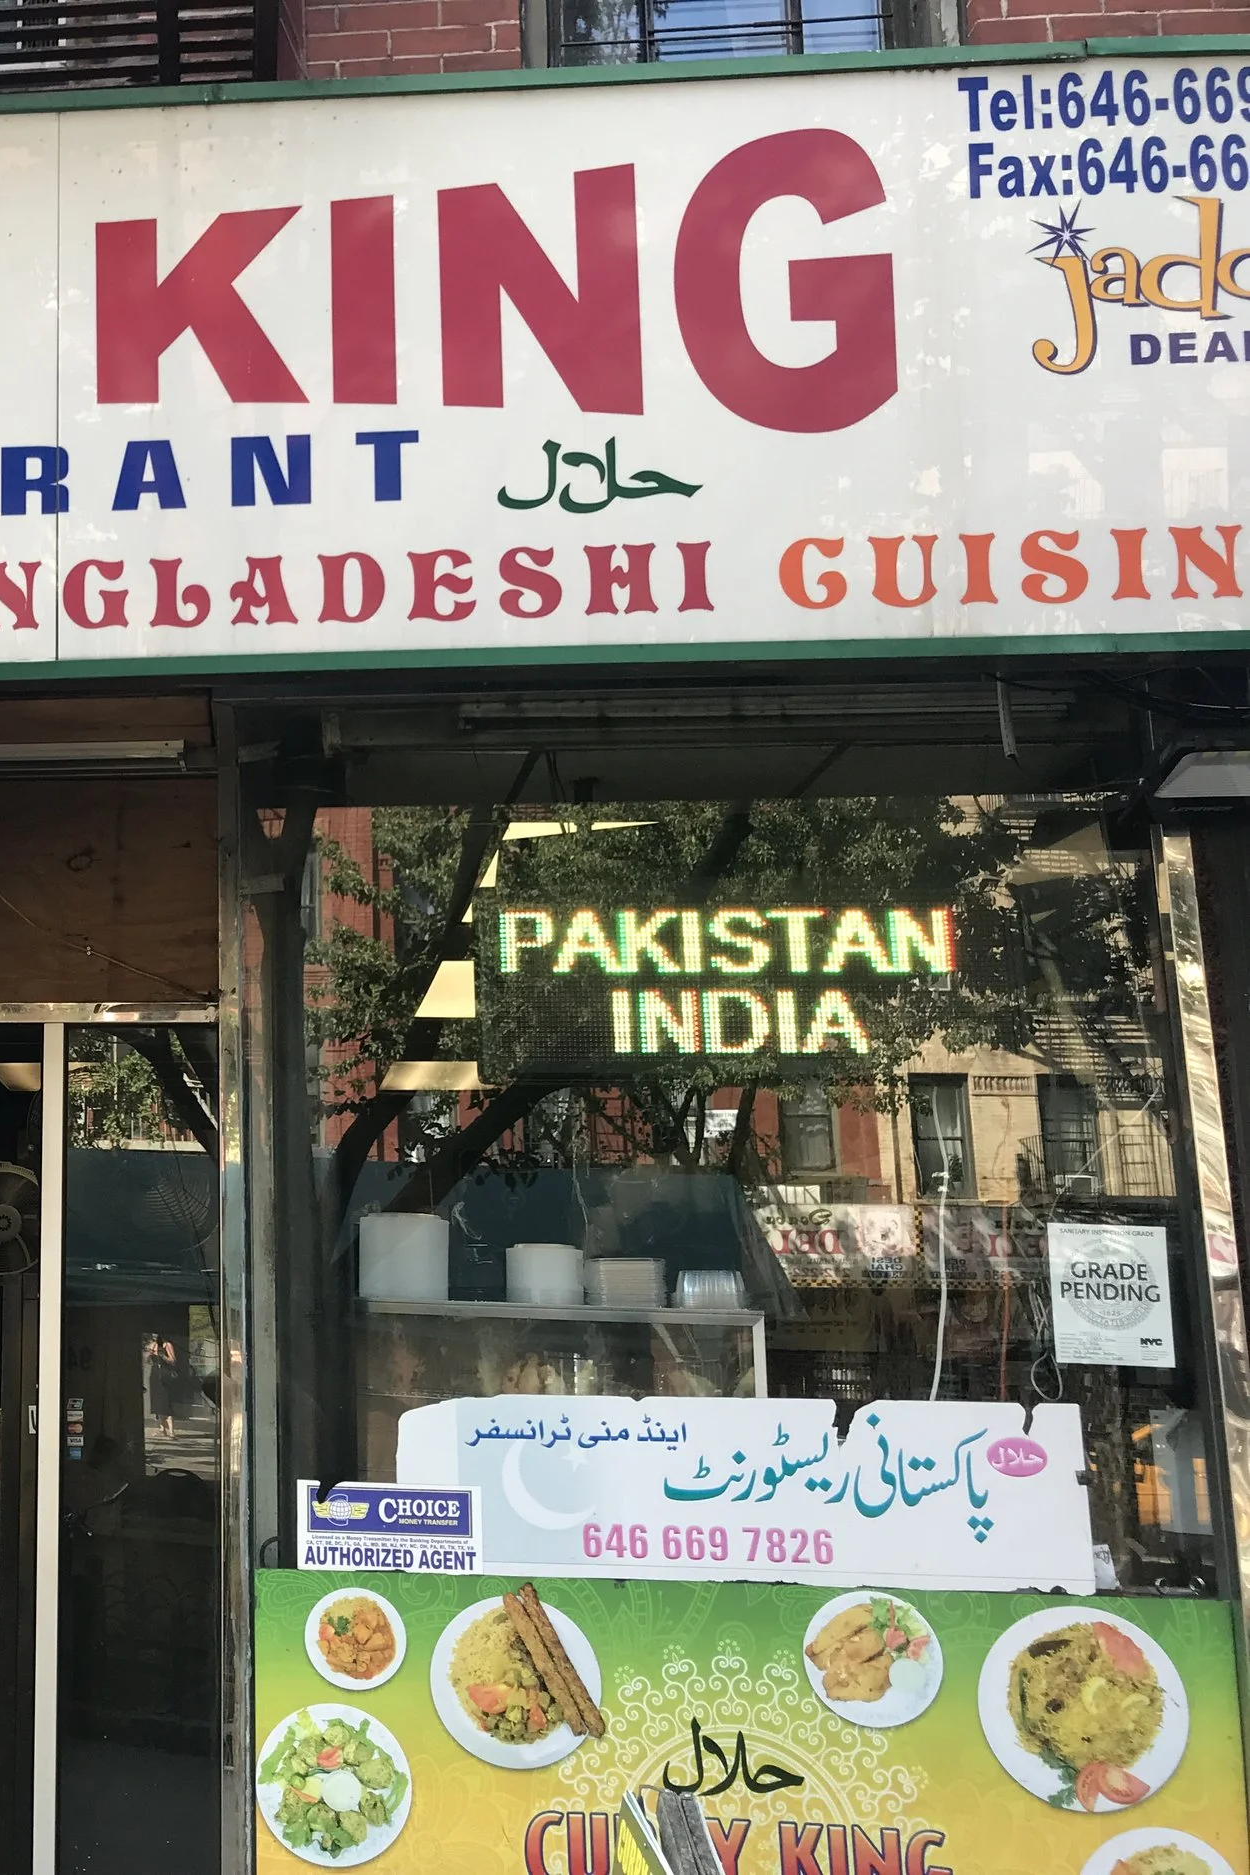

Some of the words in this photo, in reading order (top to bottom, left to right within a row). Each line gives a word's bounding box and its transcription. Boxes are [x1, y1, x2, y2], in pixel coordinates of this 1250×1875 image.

[95, 128, 898, 433] KING
[1130, 331, 1250, 365] DEA
[497, 436, 703, 513] حلال
[778, 525, 1243, 609] CUISIN
[500, 909, 954, 975] PAKISTAN
[612, 989, 869, 1055] INDIA
[1060, 1281, 1161, 1302] PENDING
[1070, 1261, 1148, 1281] GRADE
[1140, 1337, 1163, 1346] NYC
[378, 1498, 460, 1524] CHOICE
[304, 1546, 414, 1568] AUTHORIZED
[418, 1550, 477, 1570] AGENT
[582, 1522, 649, 1559] 646
[661, 1524, 729, 1562] 669
[741, 1526, 835, 1565] 7826
[662, 1717, 805, 1796] حلال
[524, 1811, 750, 1875] CUY
